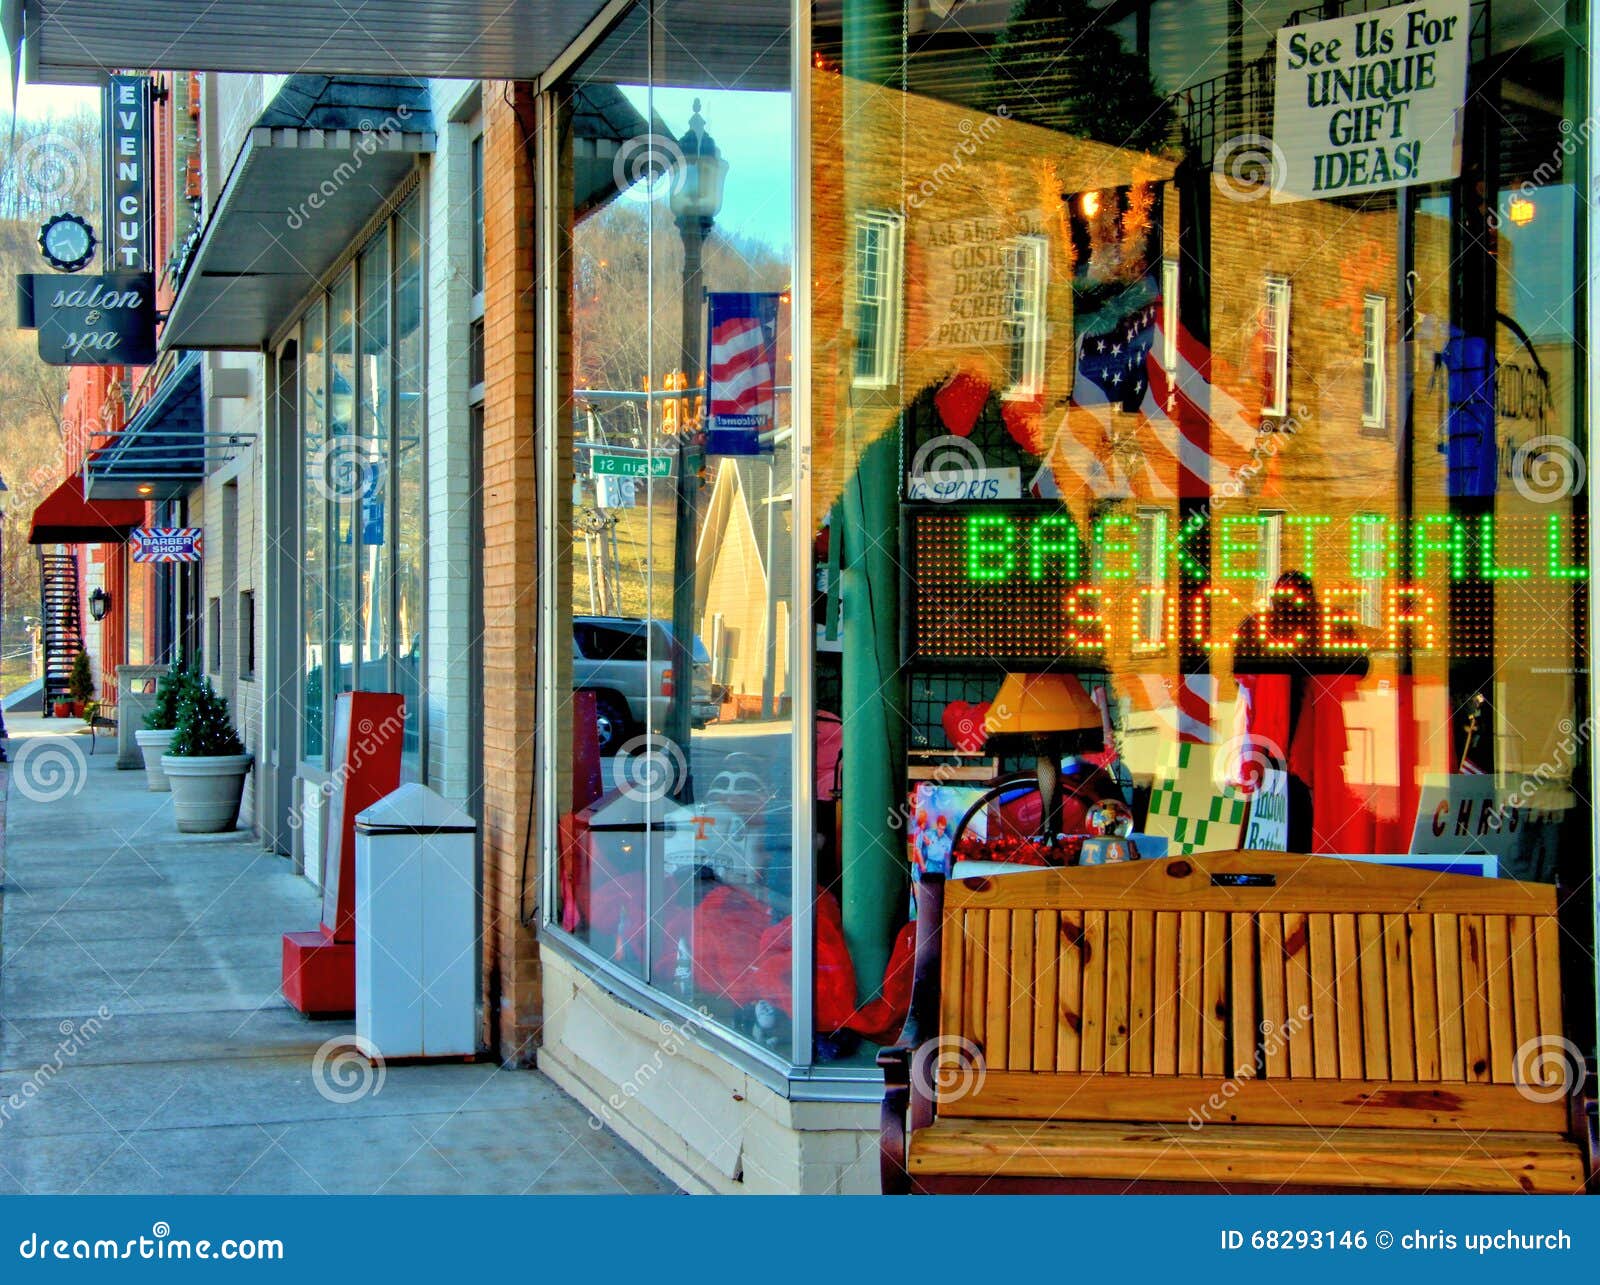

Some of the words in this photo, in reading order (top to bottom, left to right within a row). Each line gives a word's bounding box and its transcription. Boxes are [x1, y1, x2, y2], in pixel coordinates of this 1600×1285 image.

[1288, 32, 1342, 70] See
[1355, 19, 1394, 59] Us
[1406, 9, 1458, 49] For
[1307, 51, 1436, 108] UNIQUE
[119, 85, 137, 182] EVEN
[1329, 100, 1410, 147] GIFT
[1312, 140, 1421, 192] IDEAS!
[119, 197, 138, 266] CUT
[964, 220, 1004, 243] Abo
[951, 245, 1017, 271] CUSTO
[50, 284, 143, 310] salon
[85, 310, 101, 326] &
[62, 327, 122, 357] spa
[143, 537, 192, 546] BARBER
[152, 545, 184, 553] SHOP
[968, 514, 1588, 579] BASKETBALL
[1068, 586, 1436, 650] SOCCER
